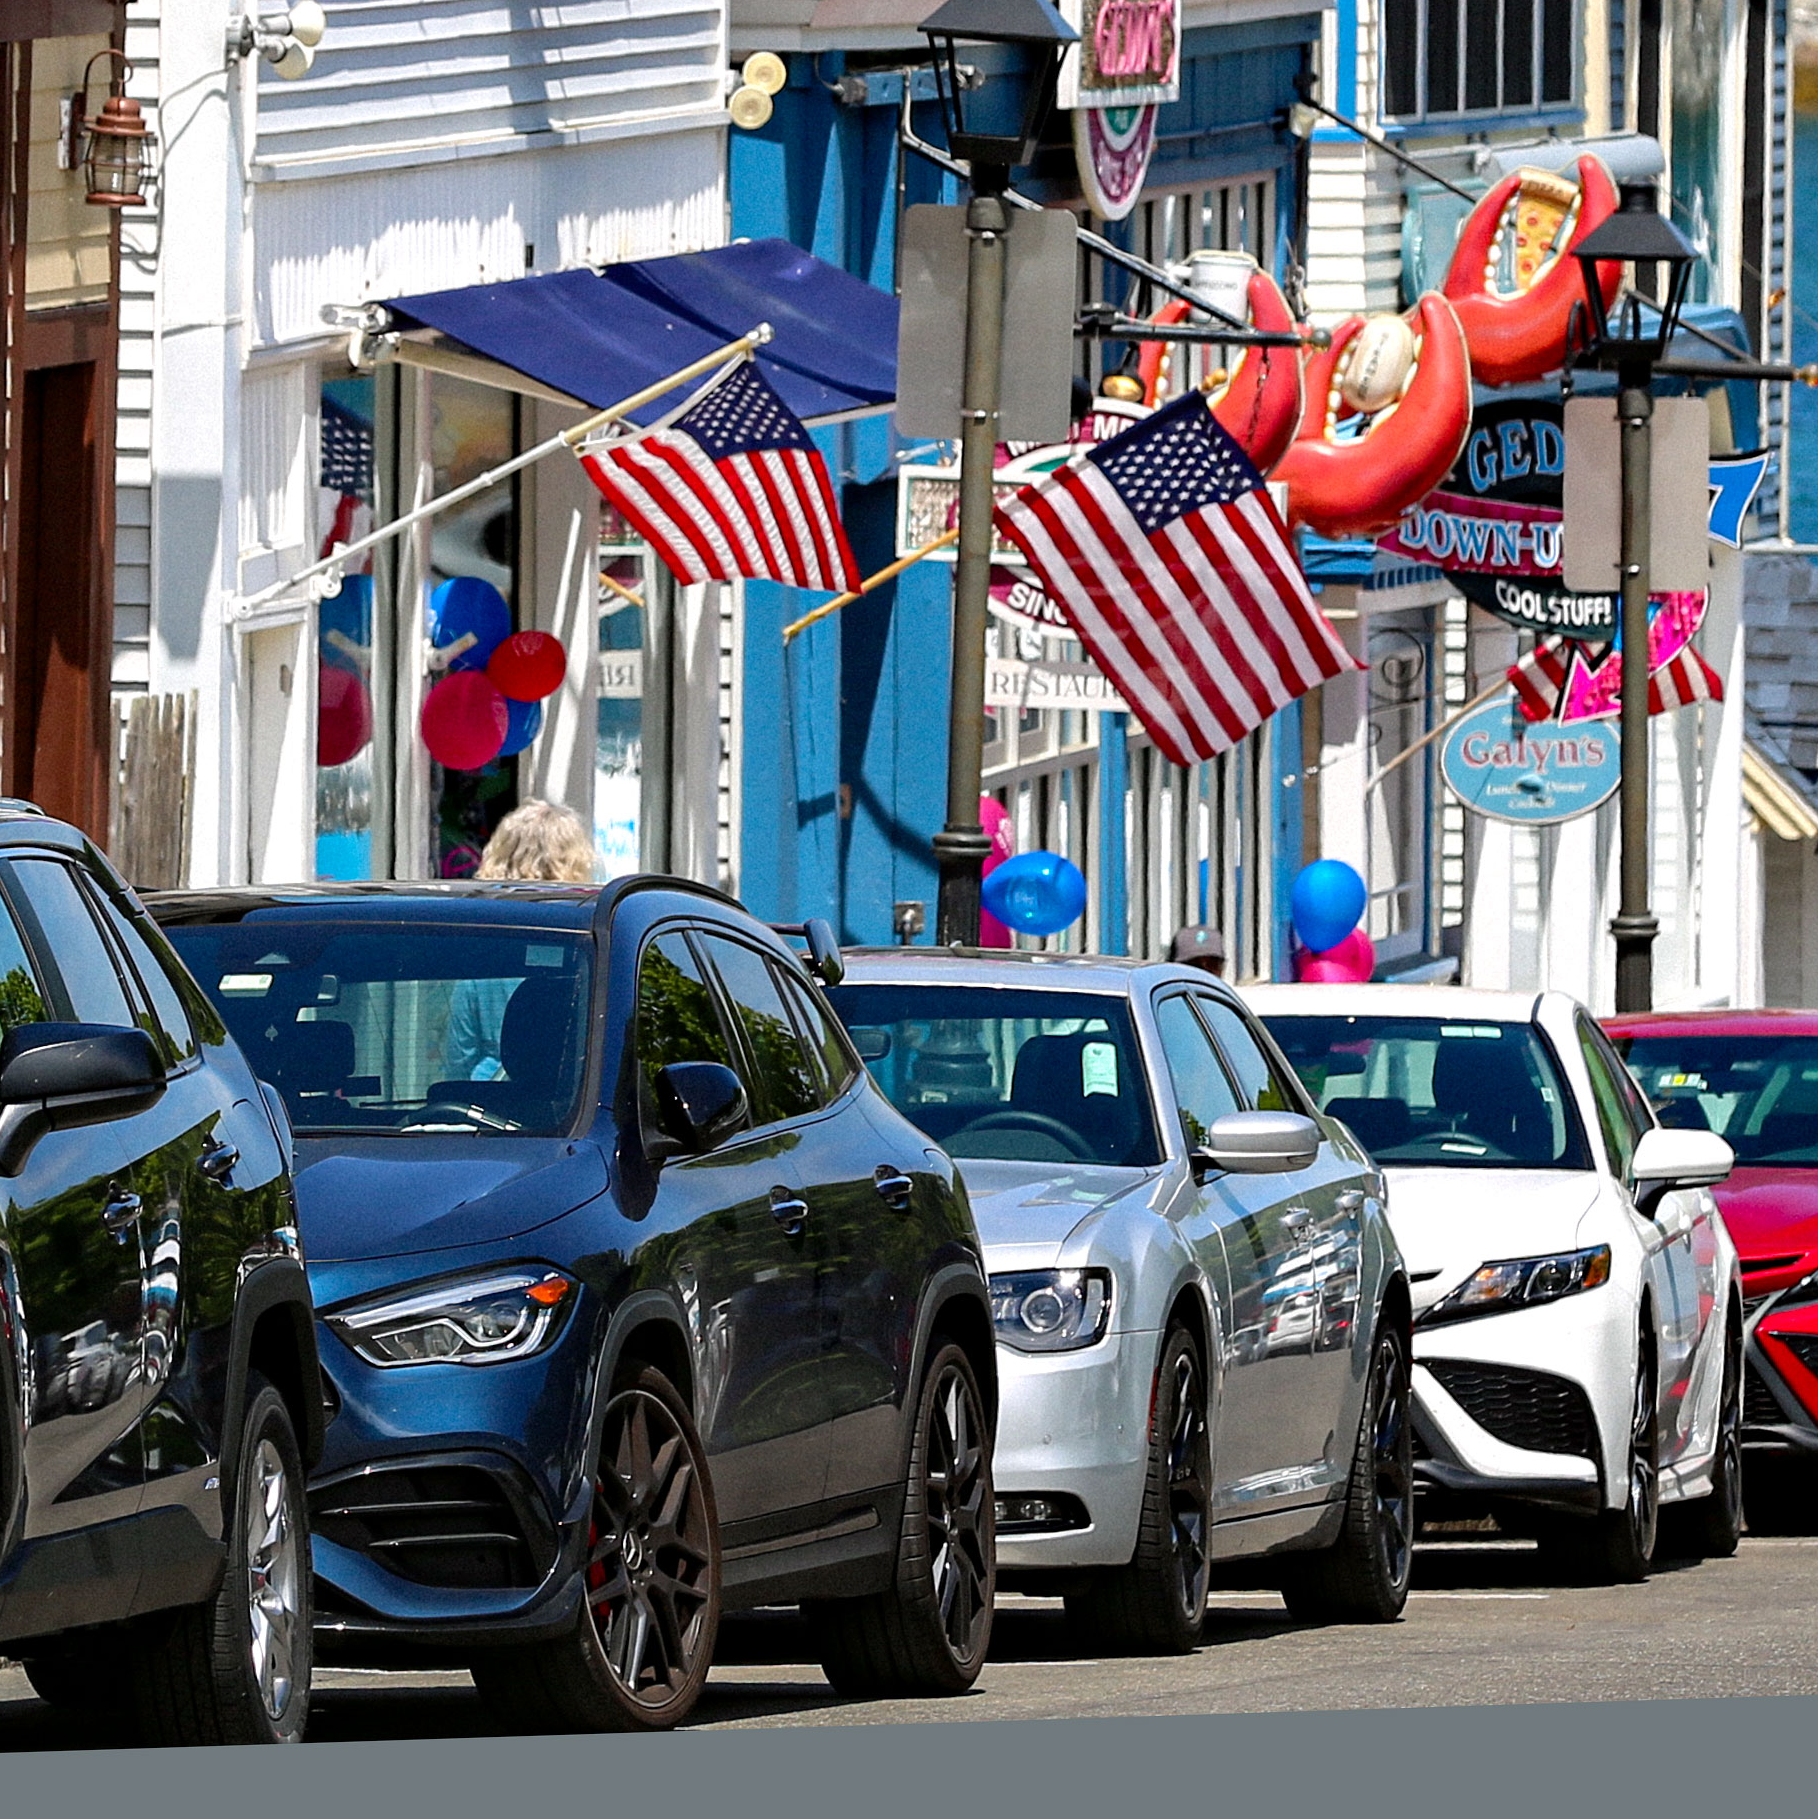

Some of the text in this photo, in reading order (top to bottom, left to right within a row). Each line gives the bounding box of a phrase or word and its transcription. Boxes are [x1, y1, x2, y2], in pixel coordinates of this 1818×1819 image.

[1467, 420, 1564, 491] GED
[1398, 507, 1564, 569] DOWN-U
[1495, 578, 1612, 626] COOL STUFF!
[1462, 730, 1605, 774] Galyn's
